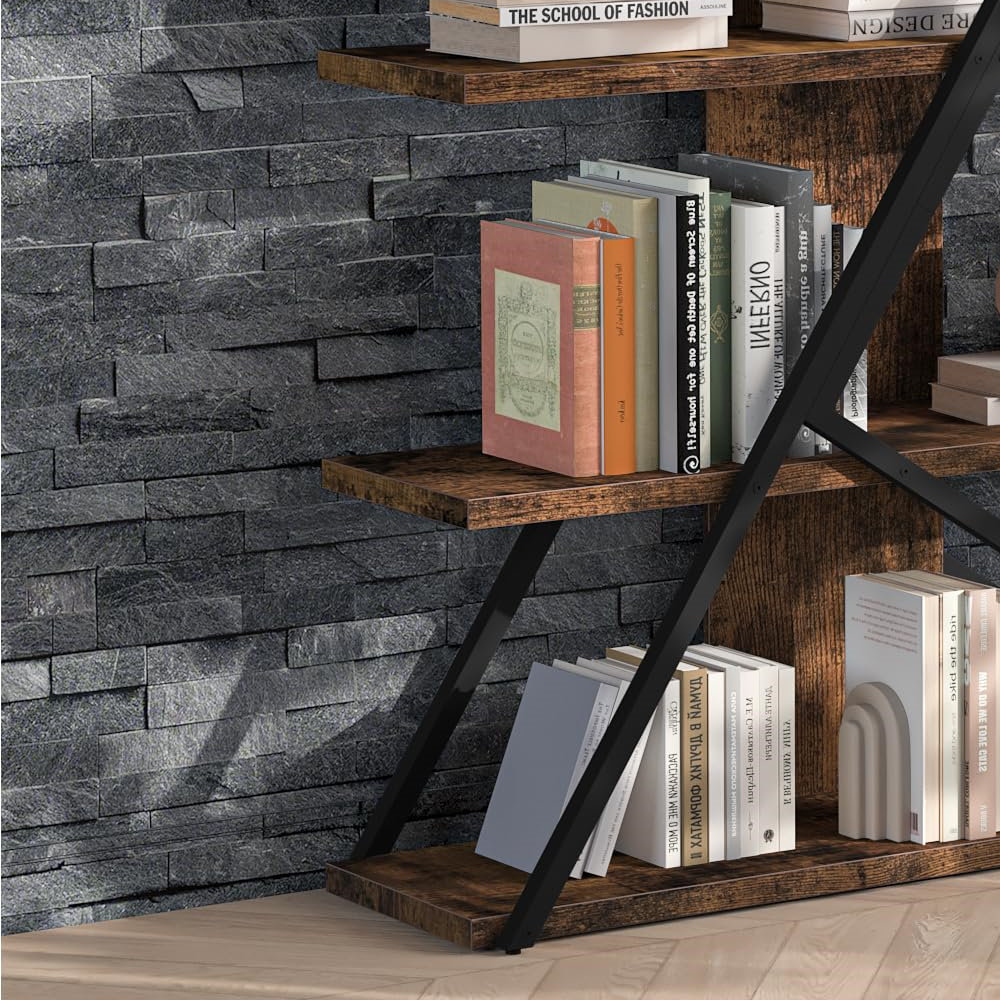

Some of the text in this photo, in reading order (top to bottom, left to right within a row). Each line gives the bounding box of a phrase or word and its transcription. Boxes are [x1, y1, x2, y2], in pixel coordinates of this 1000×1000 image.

[509, 1, 688, 25] THE SCHOOL OF FASHION
[853, 15, 933, 35] DESIGN
